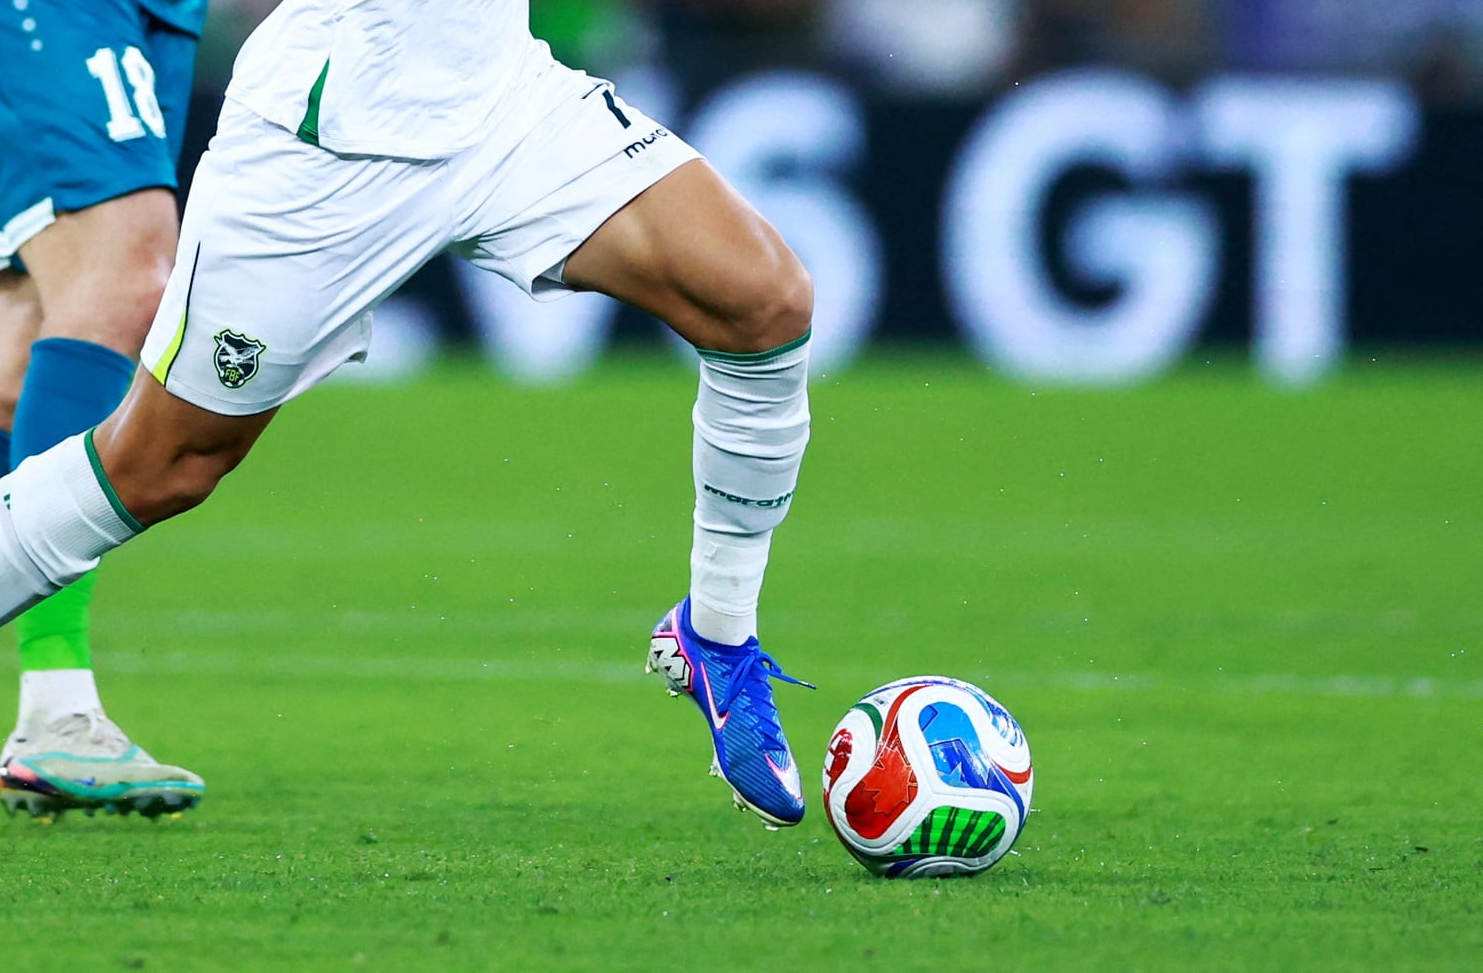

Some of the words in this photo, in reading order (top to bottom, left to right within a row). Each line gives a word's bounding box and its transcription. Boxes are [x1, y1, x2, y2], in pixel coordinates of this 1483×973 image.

[85, 45, 167, 143] 18
[581, 82, 632, 130] 7
[945, 72, 1414, 380] GT
